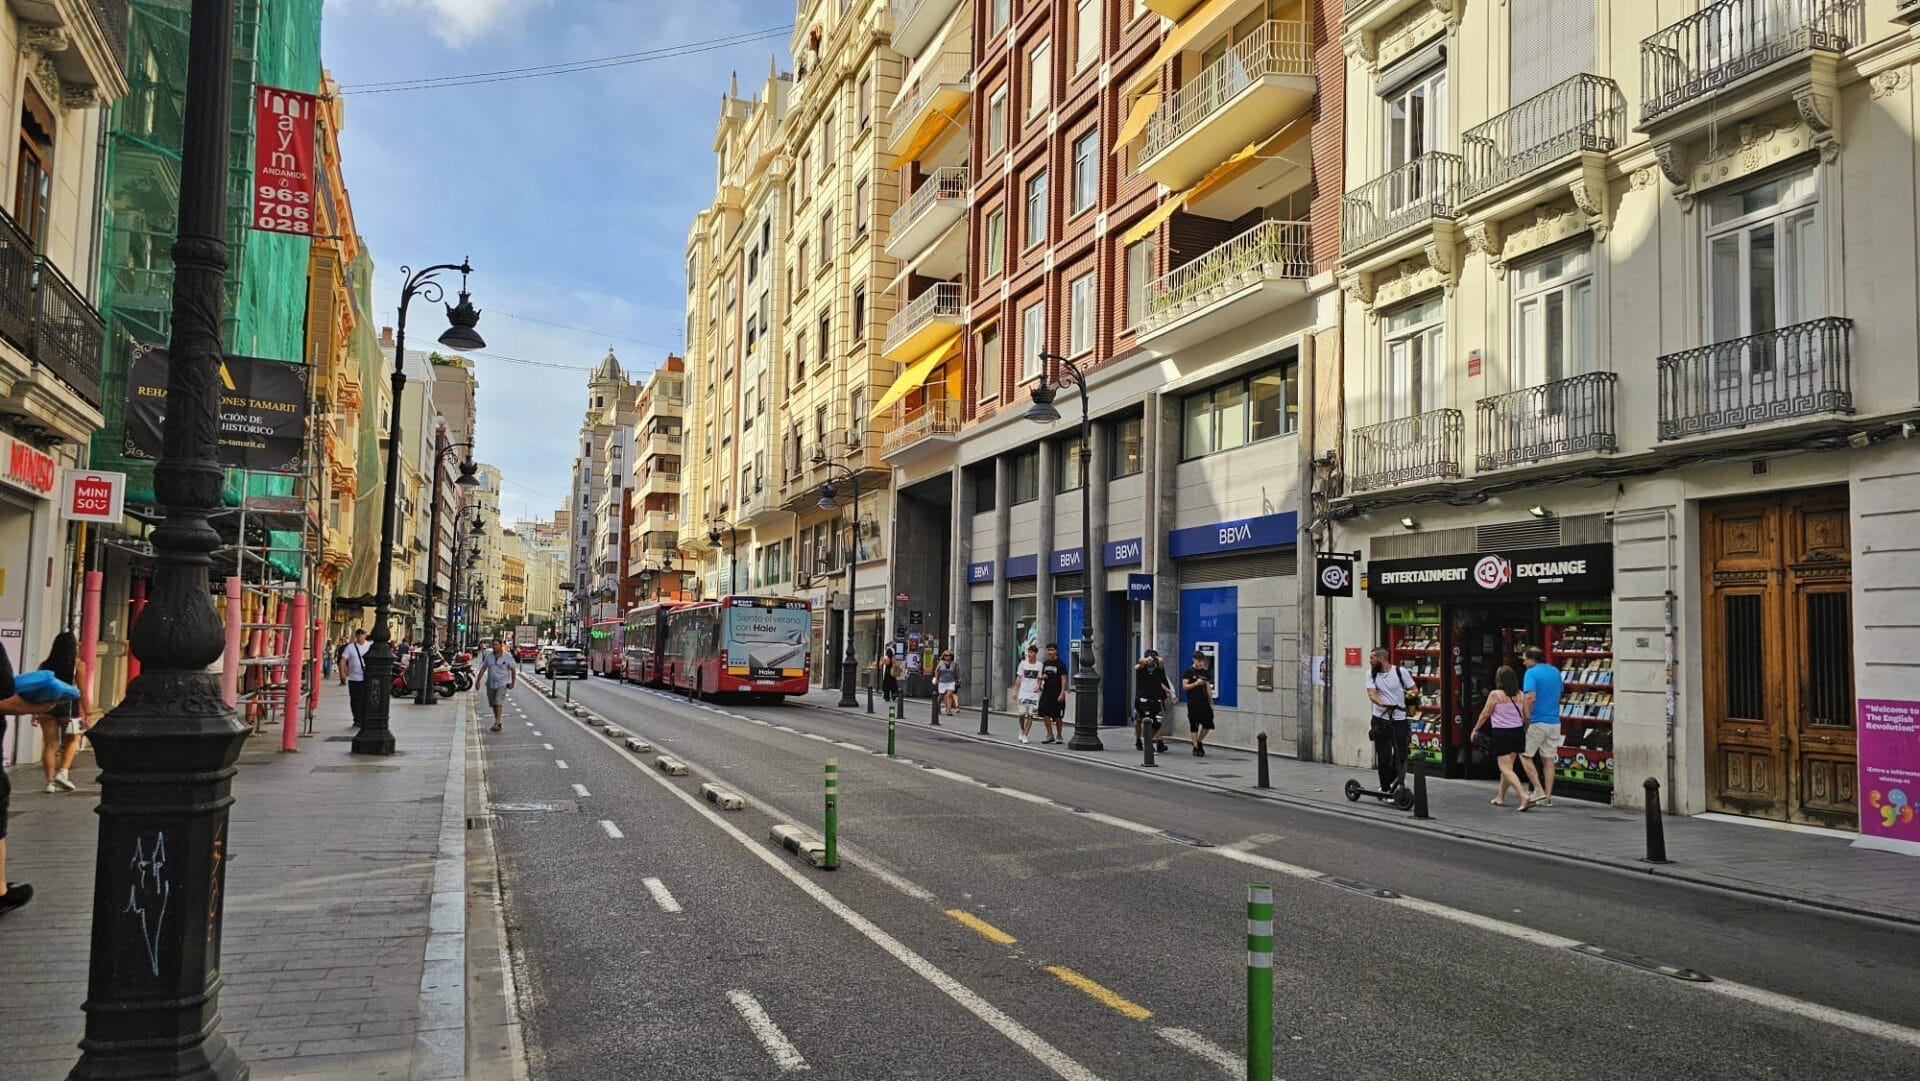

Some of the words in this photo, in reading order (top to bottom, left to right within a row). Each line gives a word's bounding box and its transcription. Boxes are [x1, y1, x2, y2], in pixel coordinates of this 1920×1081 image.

[262, 167, 307, 180] ANDAMIOS
[259, 186, 309, 204] 963
[259, 201, 309, 219] 706
[258, 216, 309, 233] 028
[248, 399, 298, 413] TAMARIT
[249, 415, 263, 424] DE
[222, 422, 274, 435] HISTÓRICO
[78, 487, 108, 498] MINI
[1219, 524, 1252, 544] BBVA
[1115, 542, 1139, 560] BBVA
[1060, 551, 1081, 567] BBVA
[974, 566, 990, 578] BBVA
[1381, 568, 1468, 584] ENTERTAINMENT
[1516, 560, 1587, 577] EXCHANGE
[1131, 583, 1152, 591] BBVA
[736, 613, 763, 622] Siente
[764, 615, 772, 623] el
[773, 616, 801, 624] verano
[753, 623, 777, 632] Haier
[1866, 713, 1882, 721] The
[1883, 714, 1914, 724] English
